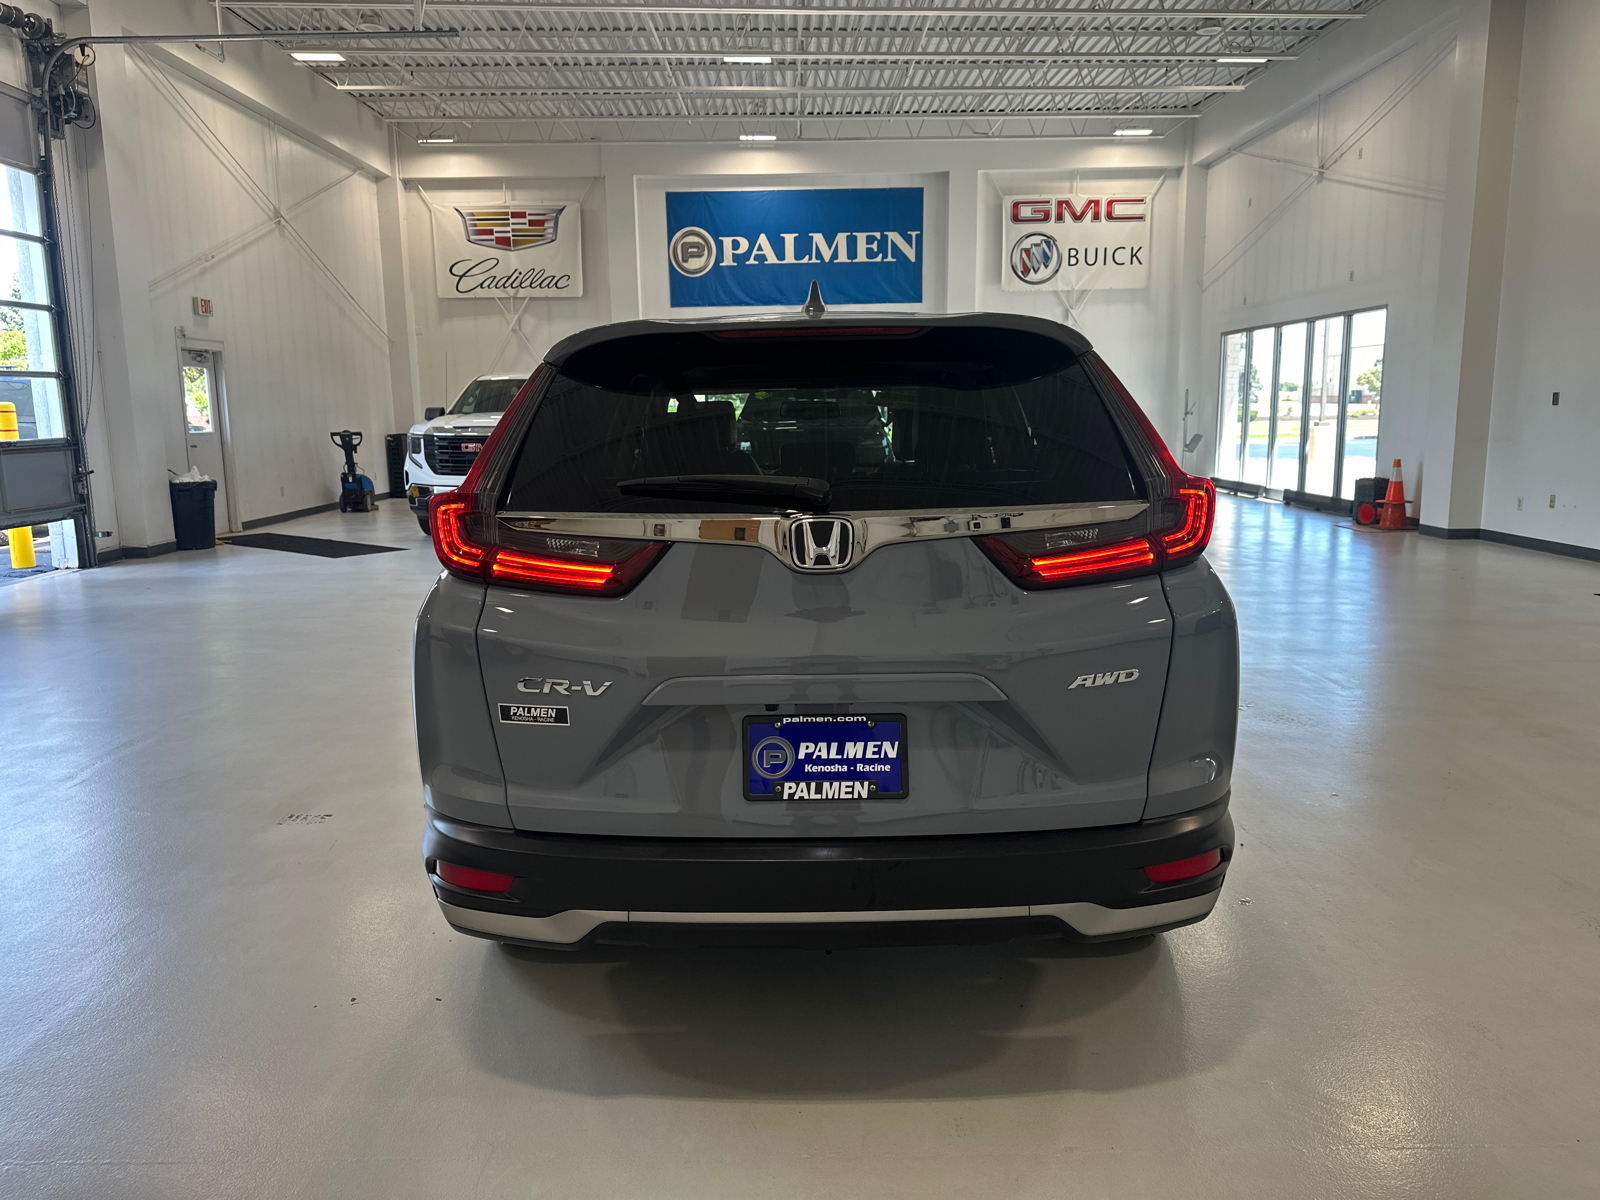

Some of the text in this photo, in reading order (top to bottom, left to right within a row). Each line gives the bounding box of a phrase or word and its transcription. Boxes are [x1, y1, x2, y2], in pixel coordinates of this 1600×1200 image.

[1010, 197, 1146, 224] GMC
[718, 231, 921, 266] PALMEN
[1067, 246, 1143, 267] BUICK
[449, 257, 571, 294] Cadillac
[516, 676, 614, 696] CR-V
[1067, 668, 1140, 690] AWD
[510, 706, 556, 718] PALMEN
[783, 716, 867, 724] palmen.com
[797, 741, 899, 759] PALMEN
[804, 764, 848, 772] Kenosha
[856, 763, 891, 772] Racine
[783, 781, 869, 799] PALMEN
